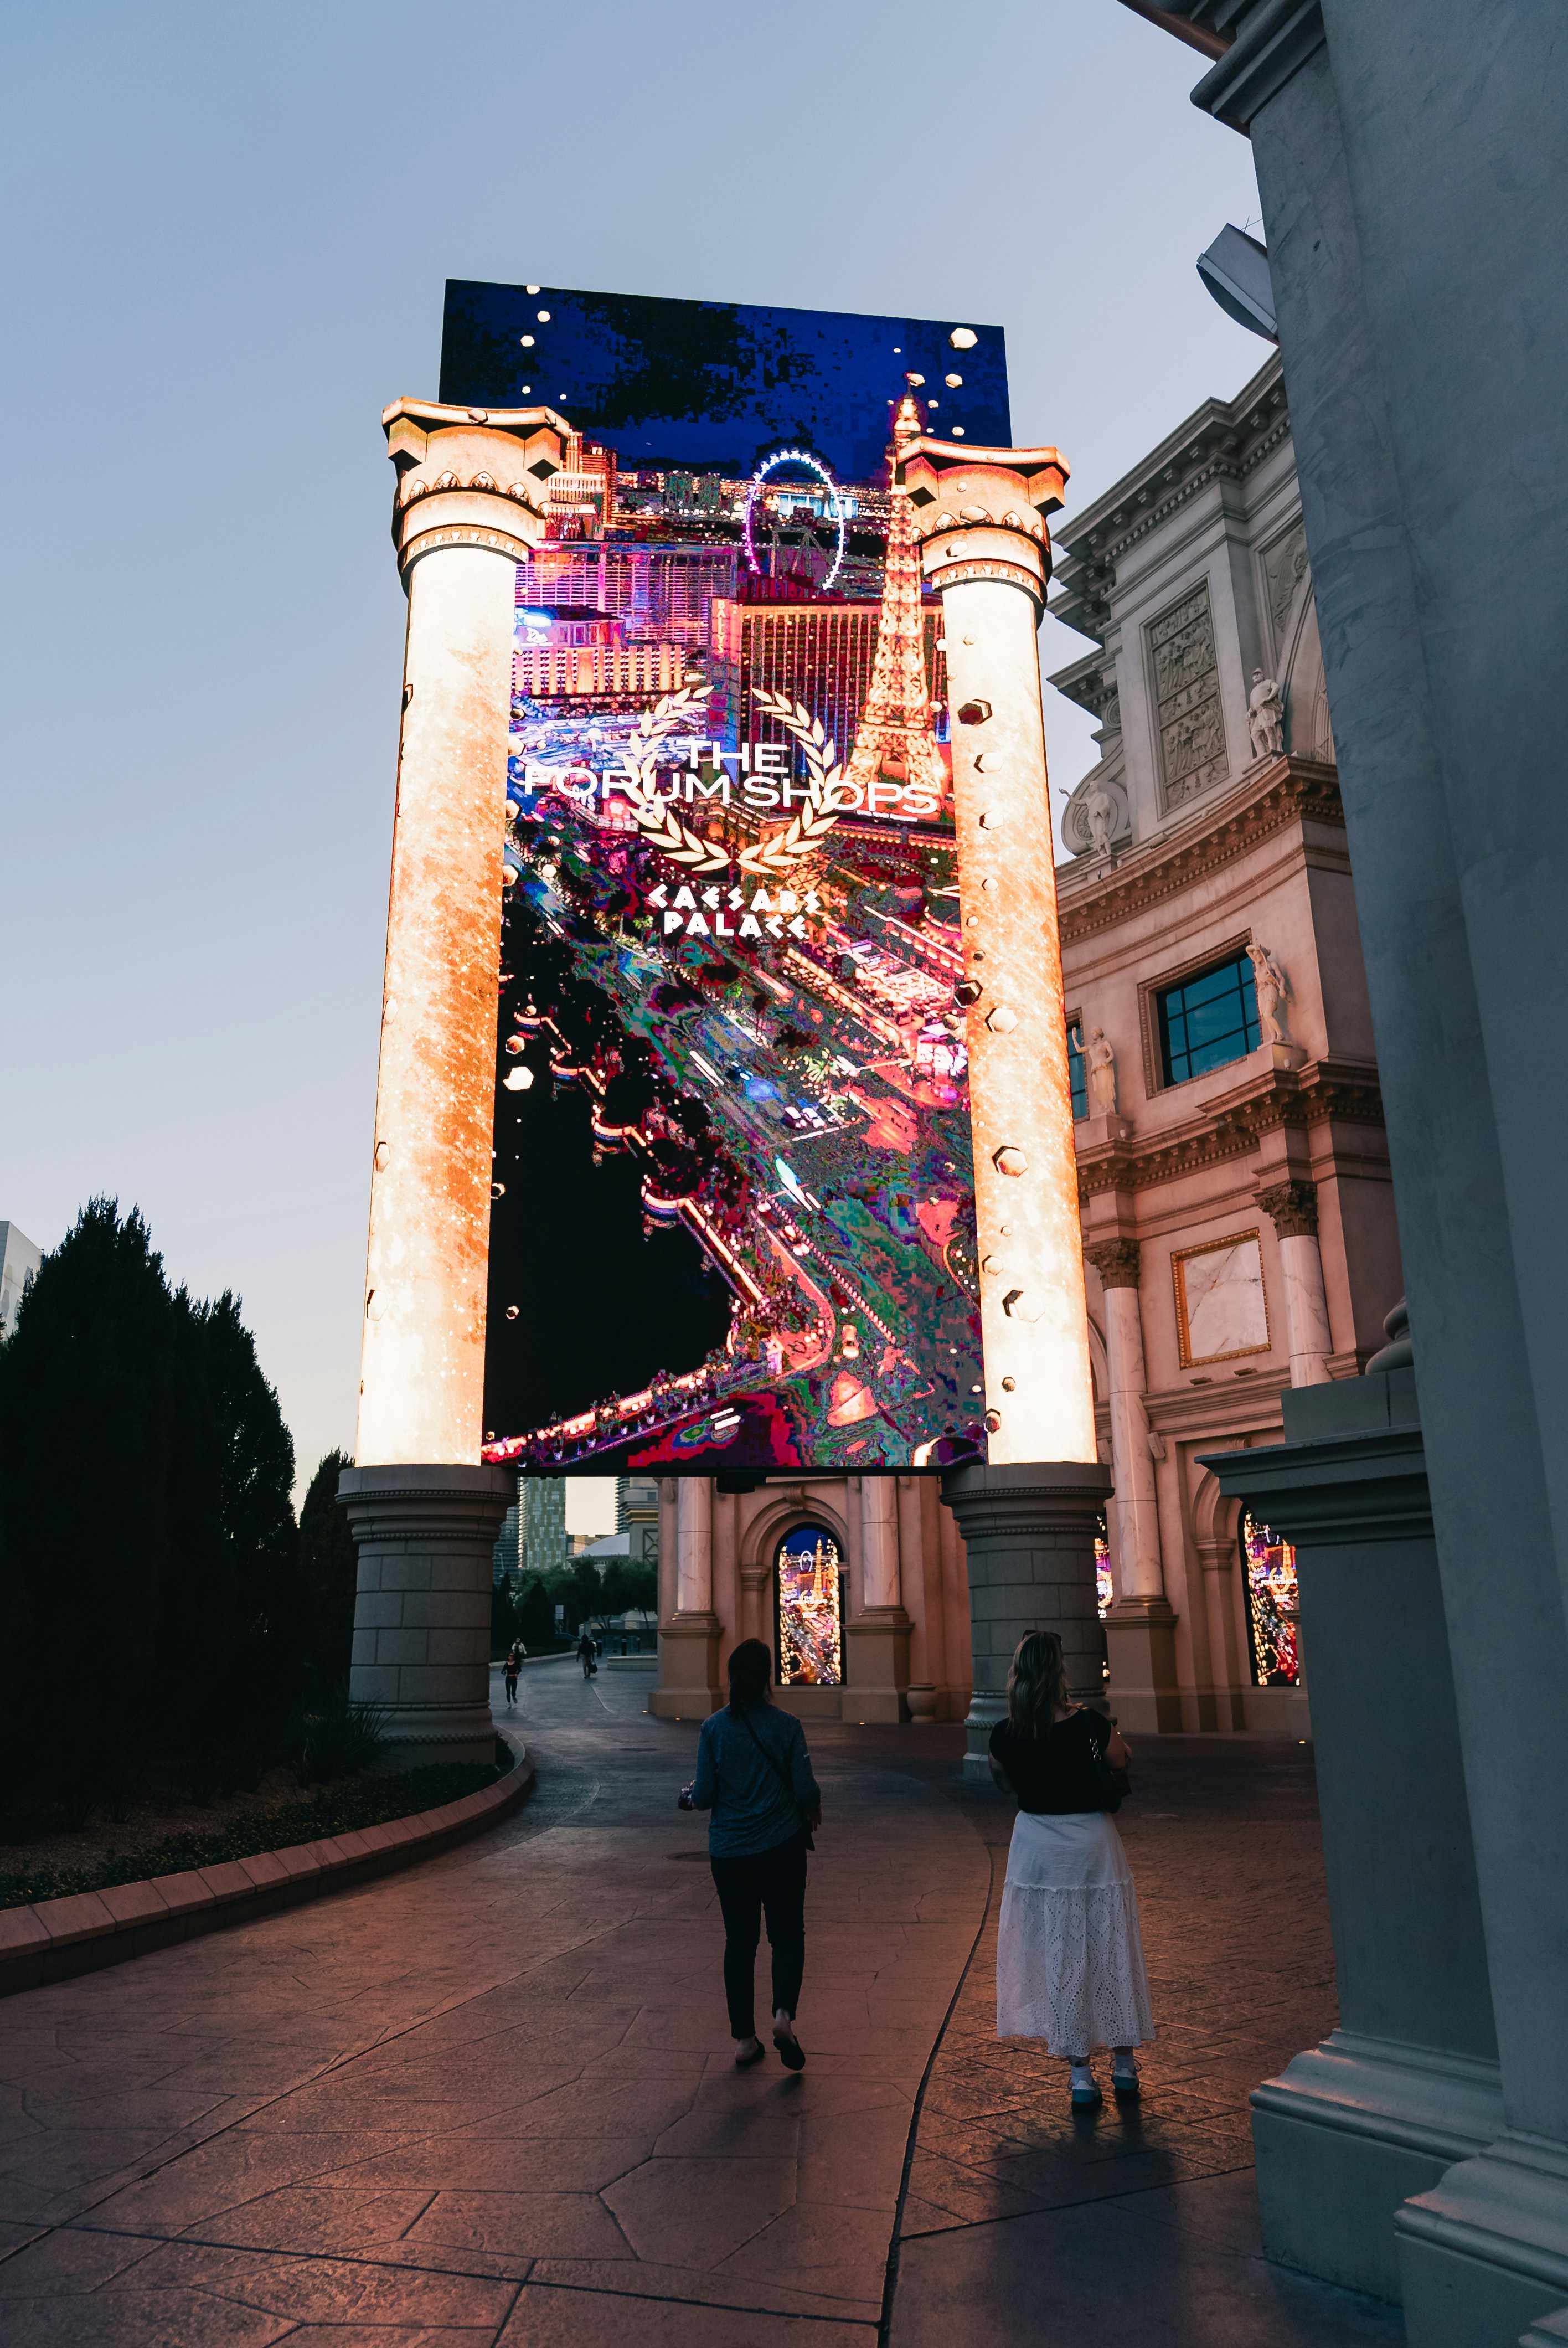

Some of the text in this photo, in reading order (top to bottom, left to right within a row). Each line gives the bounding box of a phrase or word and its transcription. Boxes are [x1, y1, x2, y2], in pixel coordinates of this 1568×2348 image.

[675, 739, 789, 774] THE
[524, 765, 938, 814] FORUM SHOPS
[648, 883, 821, 914] CAESARS
